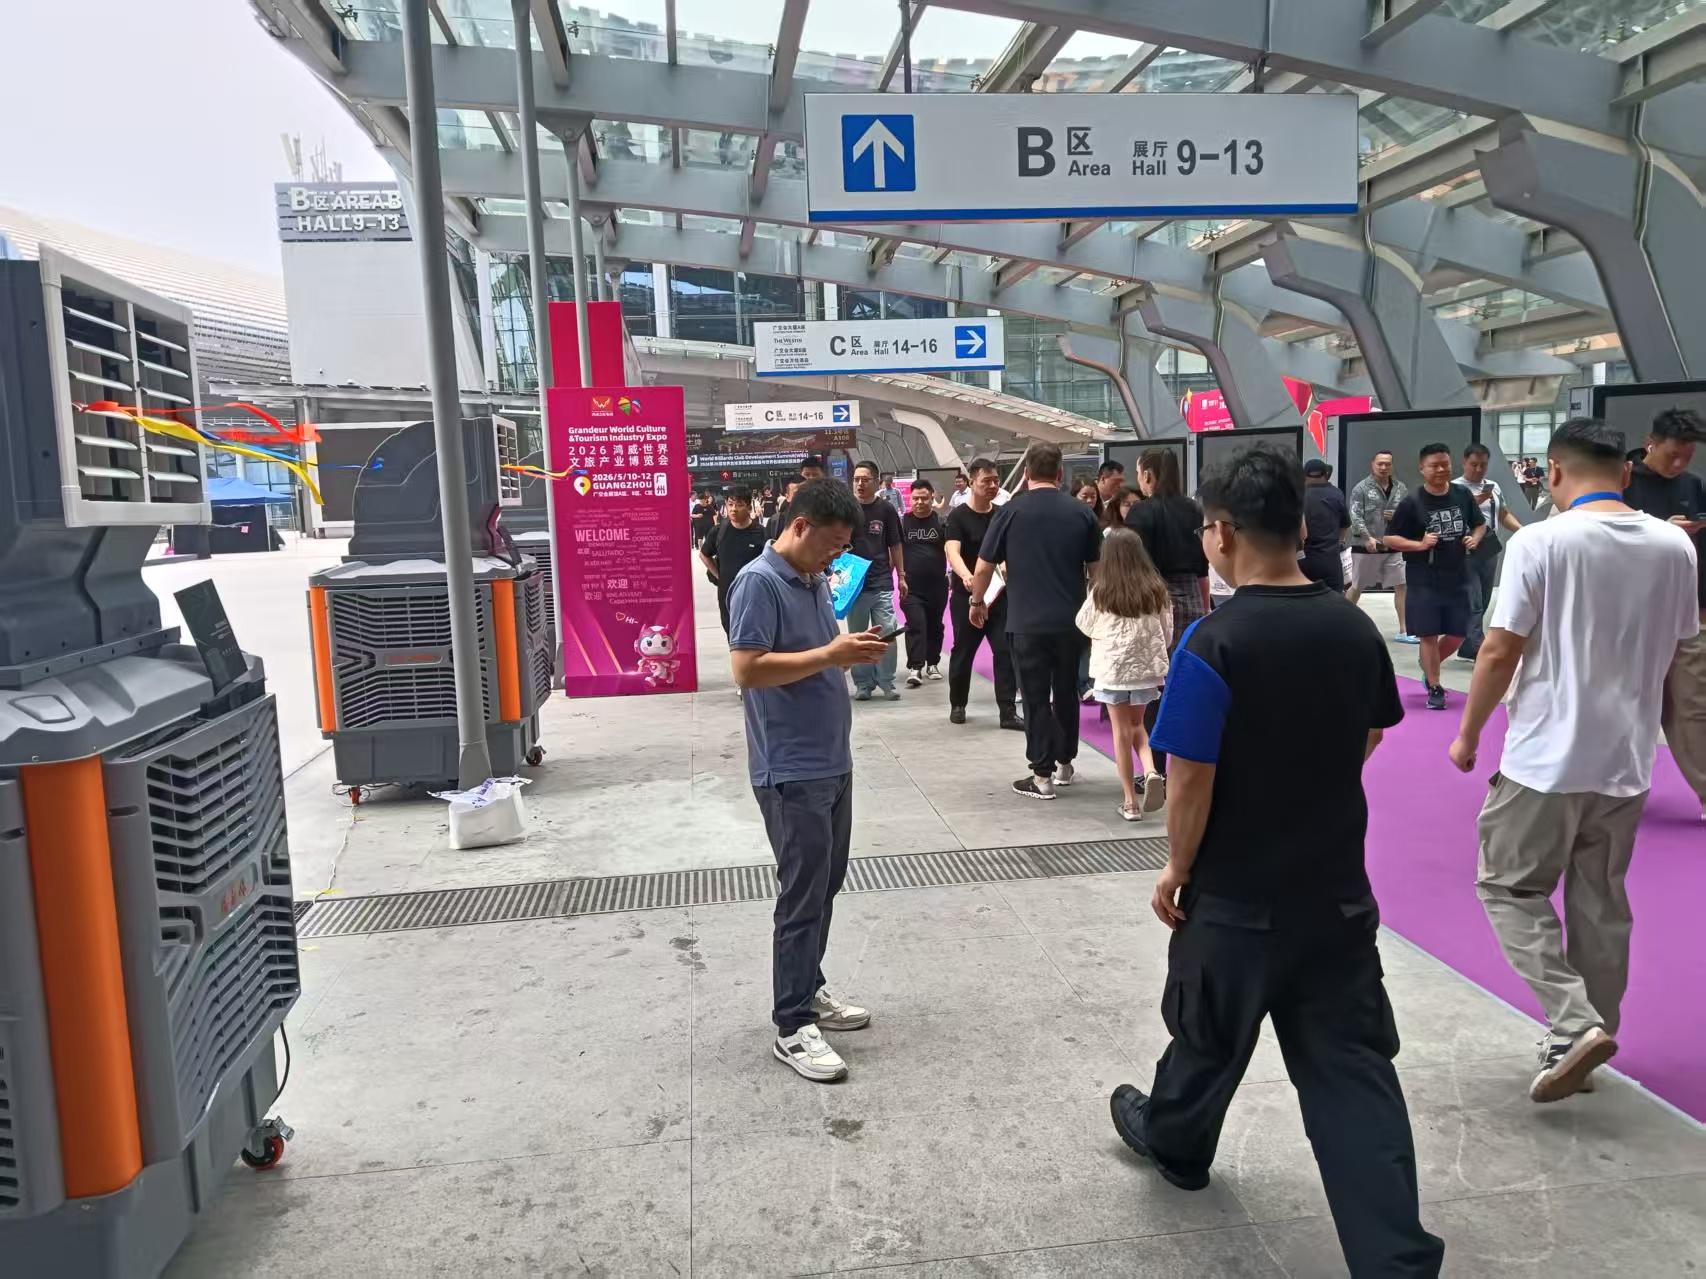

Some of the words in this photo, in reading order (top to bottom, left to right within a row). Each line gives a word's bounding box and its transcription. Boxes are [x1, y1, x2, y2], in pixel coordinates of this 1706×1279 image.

[1017, 126, 1056, 177] B
[1066, 126, 1094, 156] 区
[1132, 140, 1168, 158] 展厅
[1176, 138, 1264, 176] 9-13
[1067, 159, 1111, 176] Area
[1132, 159, 1167, 176] Hall
[332, 193, 386, 210] AREA
[386, 190, 402, 210] B
[297, 215, 353, 232] HALL
[353, 213, 401, 231] 9-13
[829, 335, 846, 357] C
[851, 335, 862, 348] 区
[873, 340, 889, 349] 展厅
[892, 338, 938, 355] 14-16
[850, 348, 869, 356] Area
[874, 348, 889, 356] Hall
[764, 410, 775, 422] C
[798, 411, 824, 421] 14-16
[568, 426, 608, 435] Grandeur
[609, 425, 635, 434] World
[636, 425, 667, 433] Culture
[568, 434, 608, 443] &Tourism
[609, 433, 645, 443] Industry
[646, 433, 668, 442] Expo
[568, 446, 607, 456] 2026
[569, 454, 669, 468] 文旅产业博览会
[592, 472, 652, 481] 2026/5/10-12
[592, 481, 652, 490] GUANGZHOU
[575, 528, 630, 541] WELCOME
[907, 527, 939, 540] FILA
[607, 578, 628, 589] 欢迎
